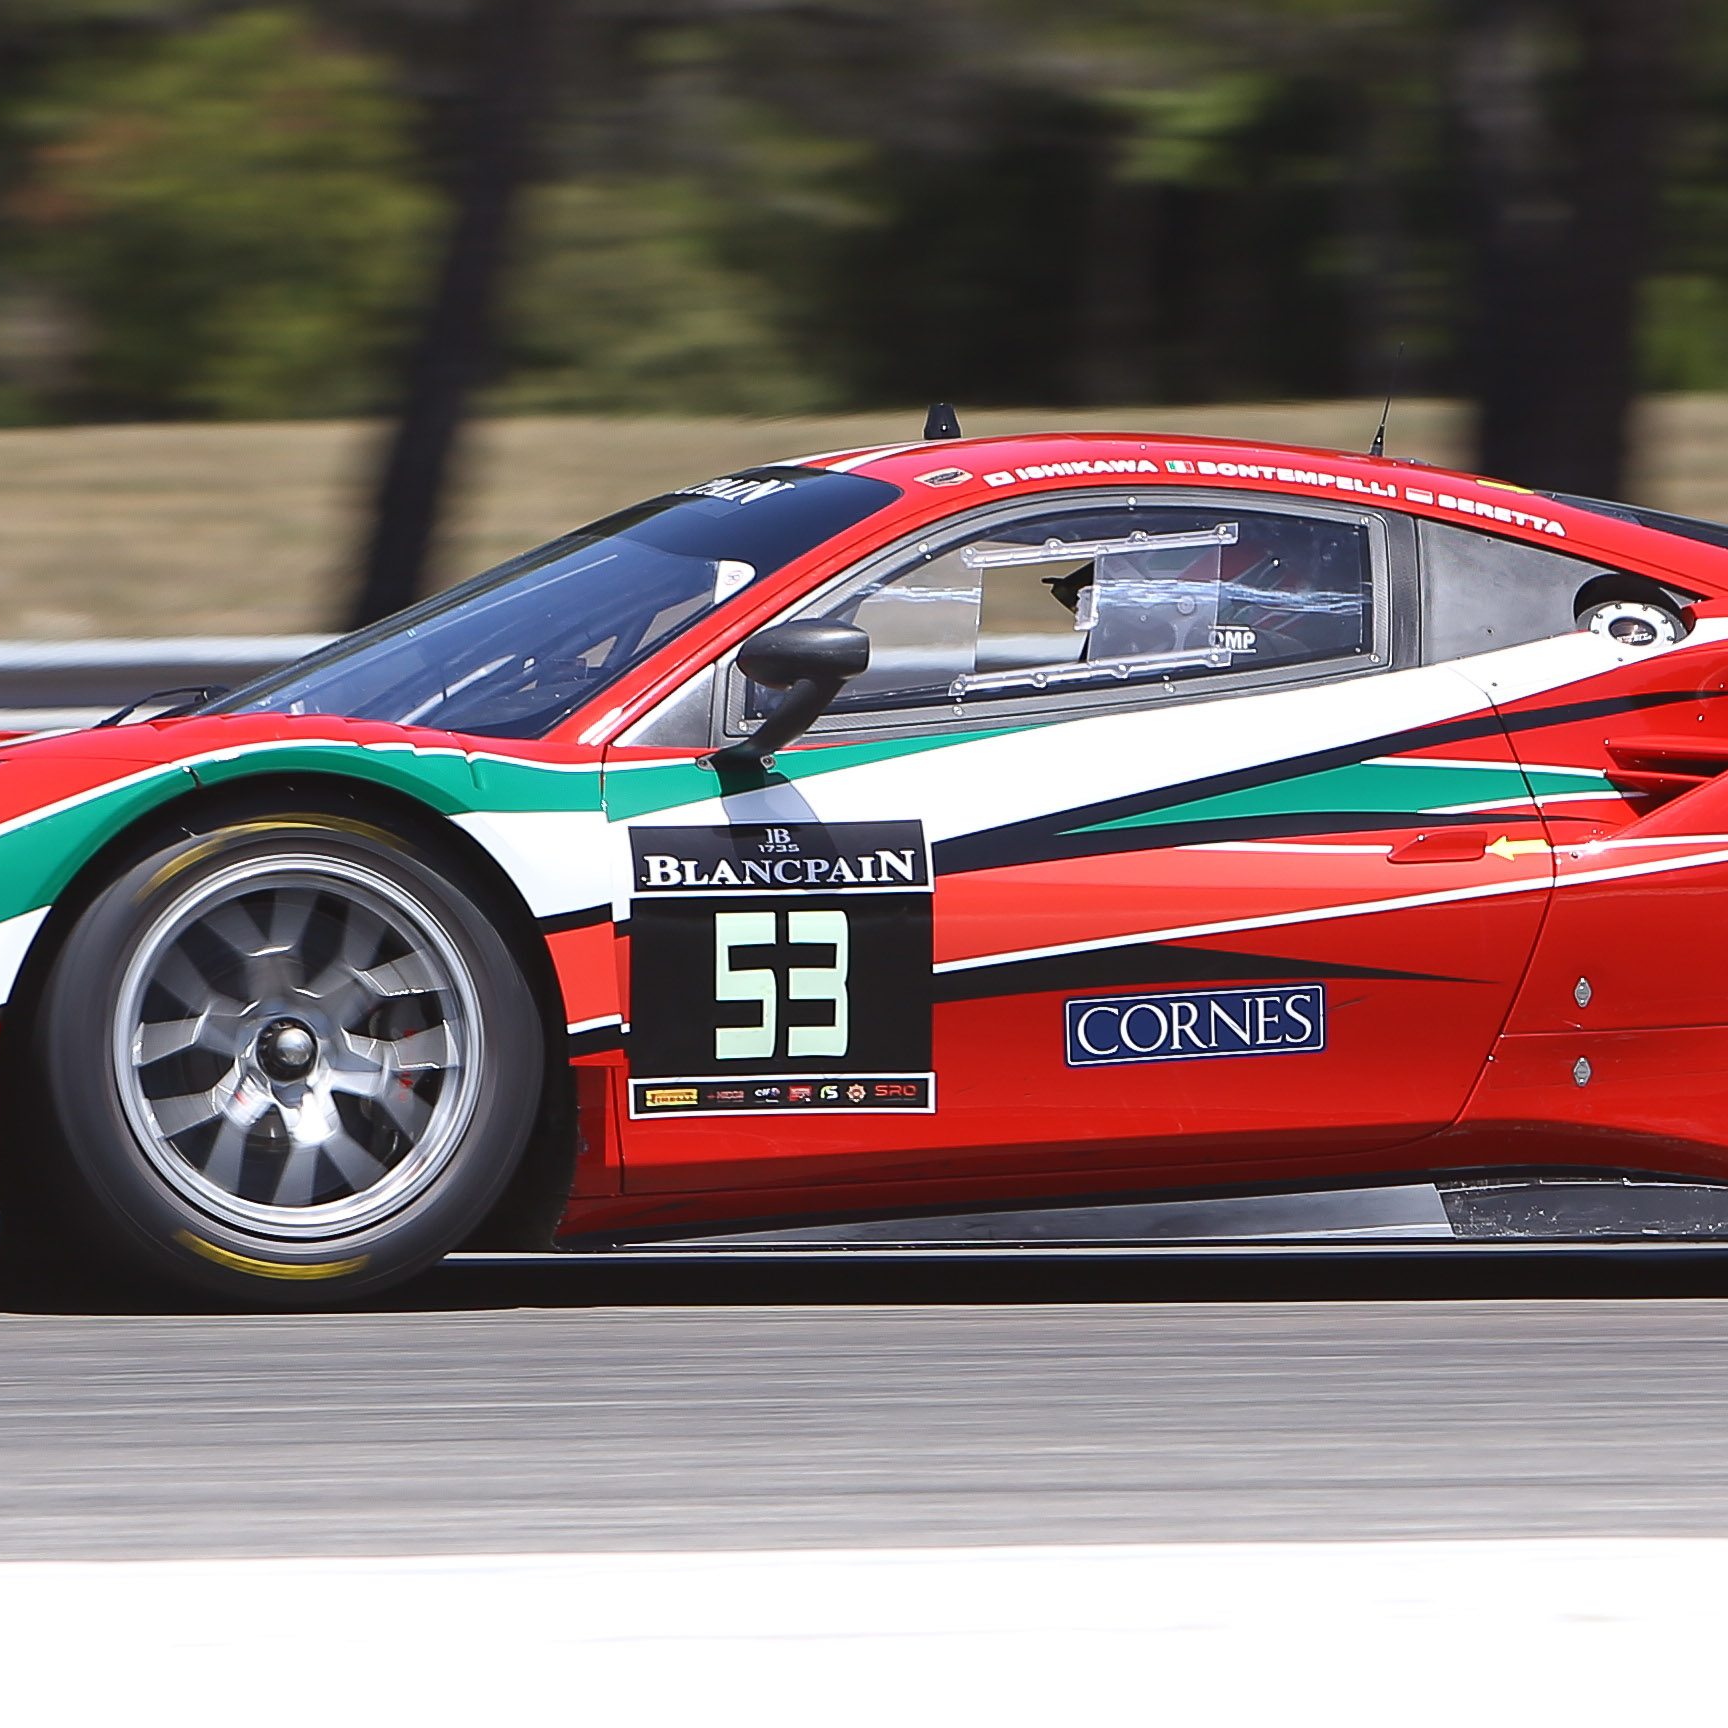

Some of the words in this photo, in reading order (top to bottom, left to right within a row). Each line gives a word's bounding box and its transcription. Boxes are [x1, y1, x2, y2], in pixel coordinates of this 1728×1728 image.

[1015, 460, 1159, 480] ISHIKAWA
[1197, 461, 1398, 498] BONTEMPELLI
[1438, 494, 1567, 537] BERETTA
[640, 850, 915, 887] BLANCPAIN
[758, 844, 800, 853] 1735
[715, 910, 849, 1060] 53
[1077, 994, 1312, 1055] CORNES
[875, 1084, 918, 1097] SRO
